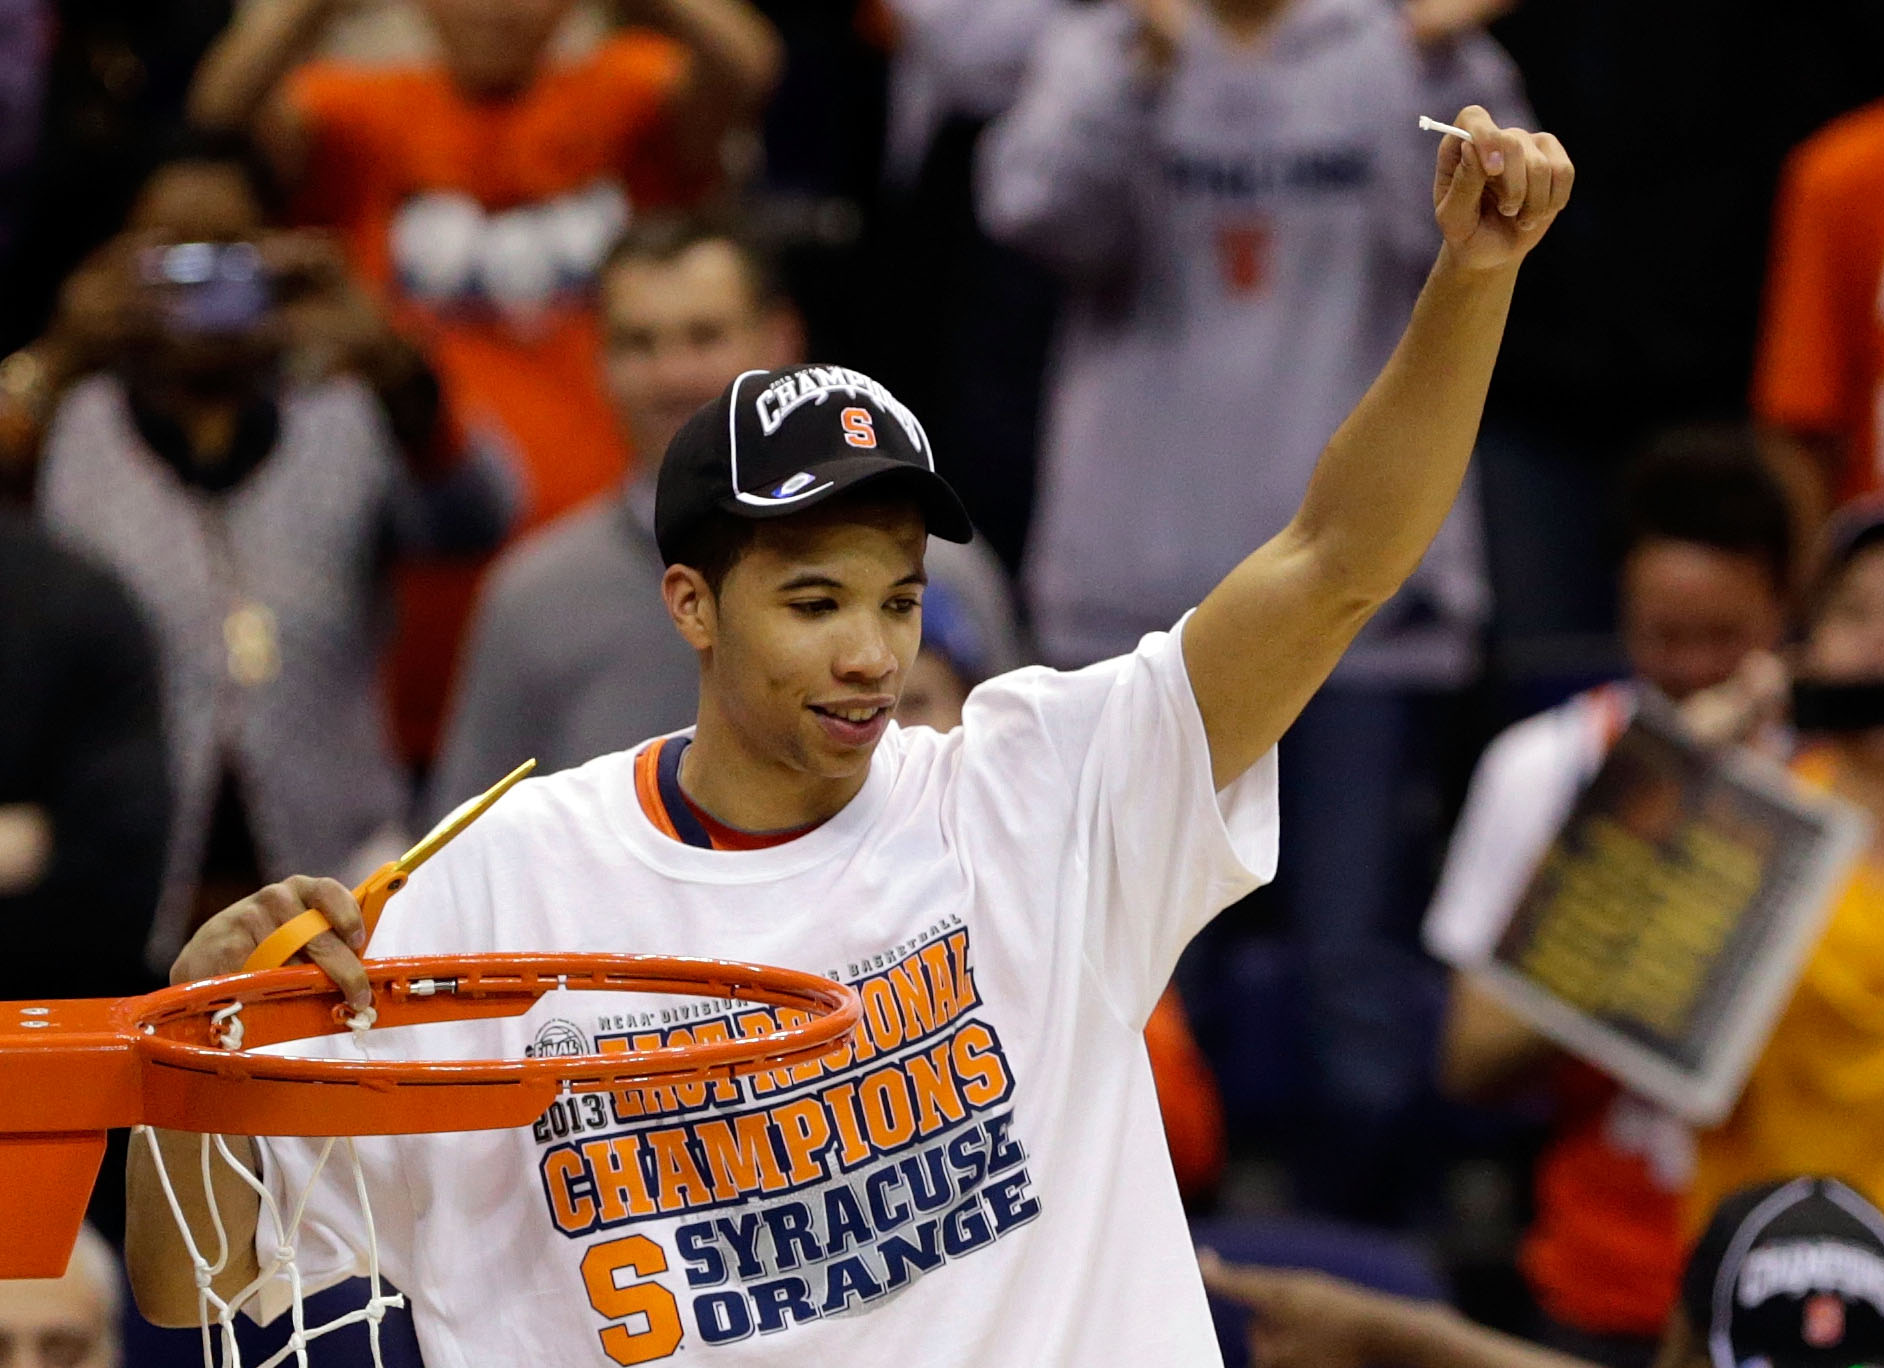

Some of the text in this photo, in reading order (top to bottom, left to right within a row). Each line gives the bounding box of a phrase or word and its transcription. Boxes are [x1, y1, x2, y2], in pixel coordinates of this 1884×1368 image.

[840, 407, 877, 449] S
[847, 913, 962, 978] BASKETBALL
[533, 1093, 609, 1144] 2013
[542, 1020, 1014, 1237] CHAMPIONS
[675, 1106, 1026, 1290] SYRACUSE
[693, 1167, 1042, 1346] ORANGE
[579, 1232, 684, 1368] S
